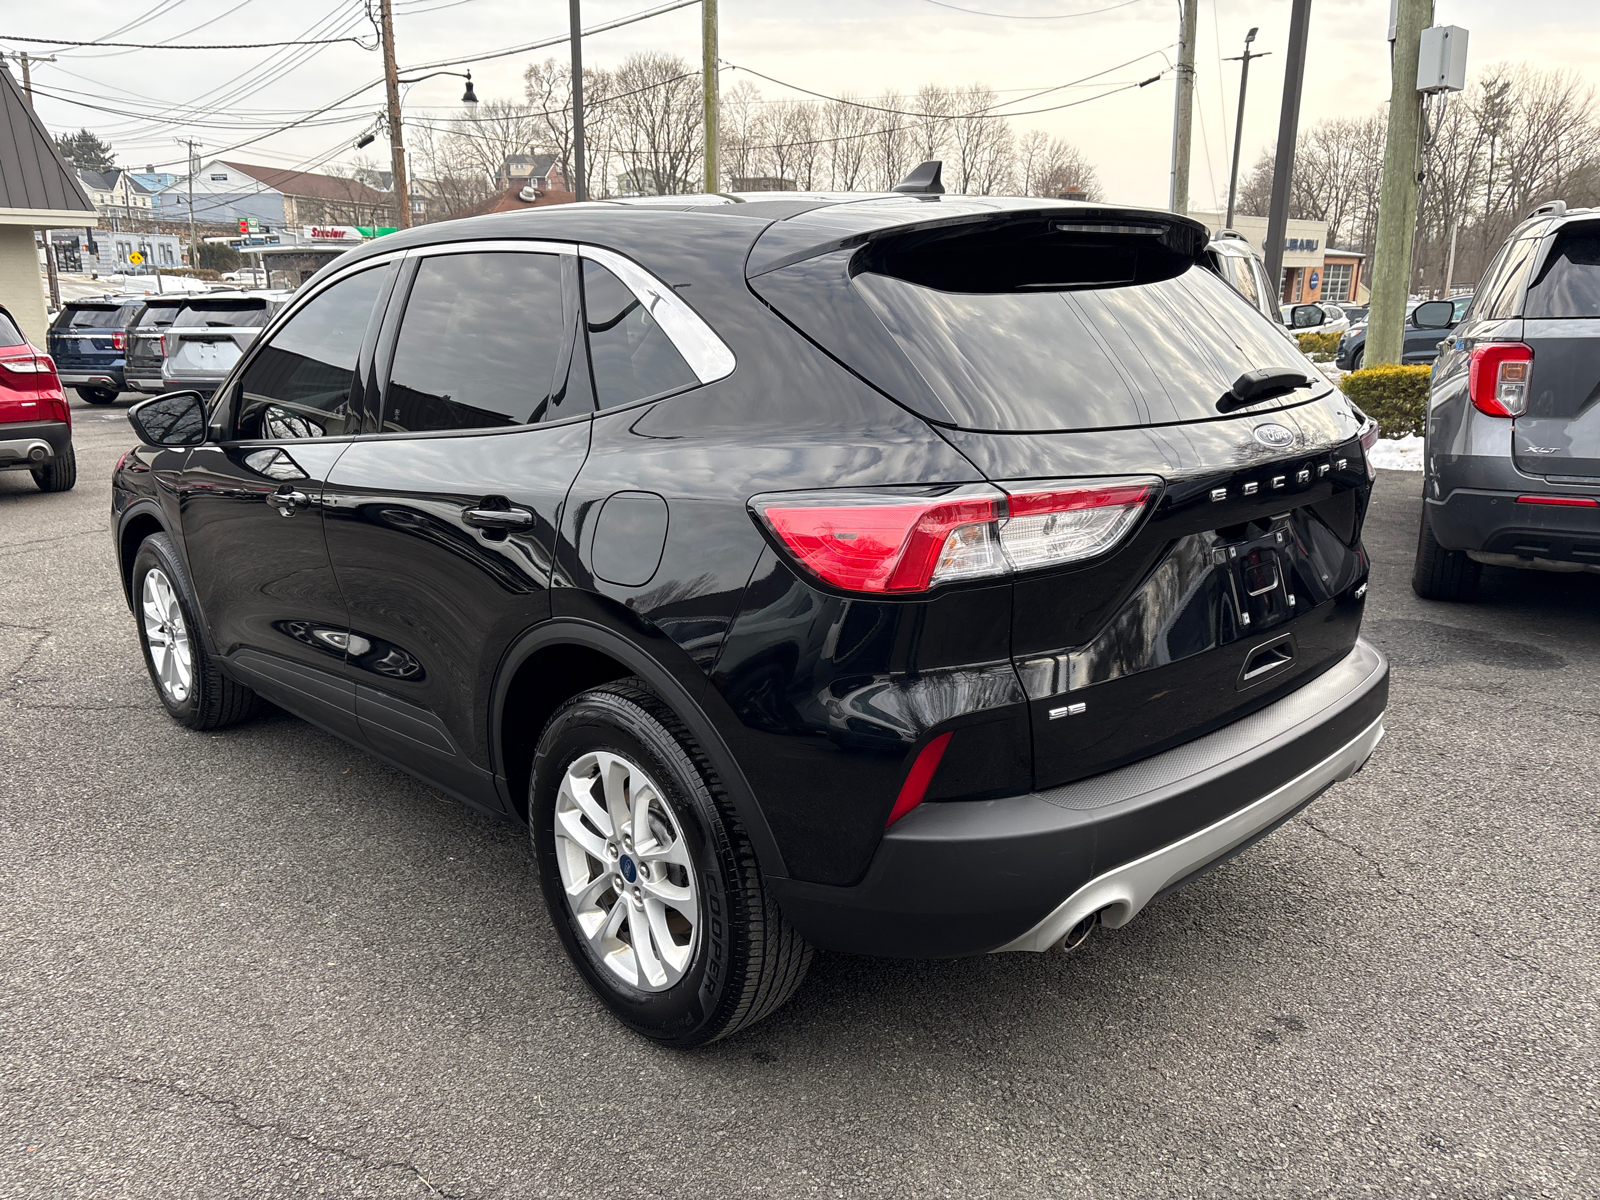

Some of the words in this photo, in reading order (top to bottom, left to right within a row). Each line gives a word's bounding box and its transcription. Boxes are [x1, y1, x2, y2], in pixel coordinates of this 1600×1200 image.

[311, 227, 346, 238] Sinclair
[1284, 238, 1319, 252] UBARU
[1524, 446, 1561, 454] XLT
[1210, 459, 1347, 502] ESCAPE
[1049, 702, 1086, 720] SE
[704, 873, 723, 995] COOPER
